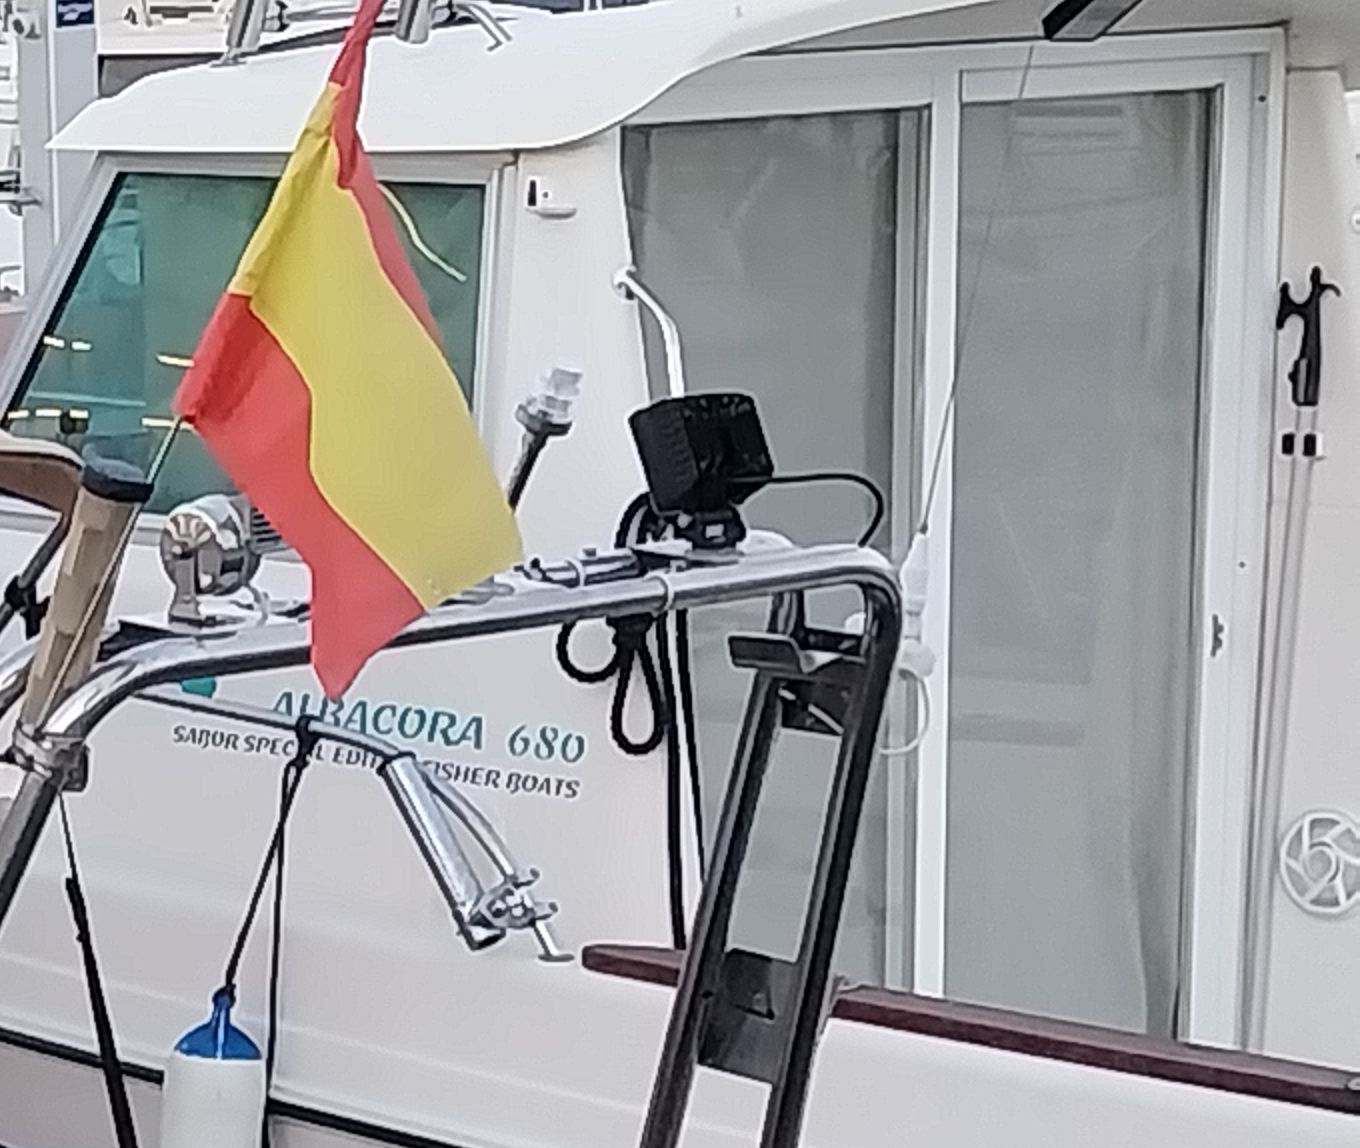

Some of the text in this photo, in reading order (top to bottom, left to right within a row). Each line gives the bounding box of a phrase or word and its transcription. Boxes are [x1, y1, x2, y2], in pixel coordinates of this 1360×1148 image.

[173, 725, 239, 750] SABOR
[243, 735, 325, 762] SPECL
[505, 772, 581, 799] BOATS
[272, 691, 585, 763] ALBACORA 680
